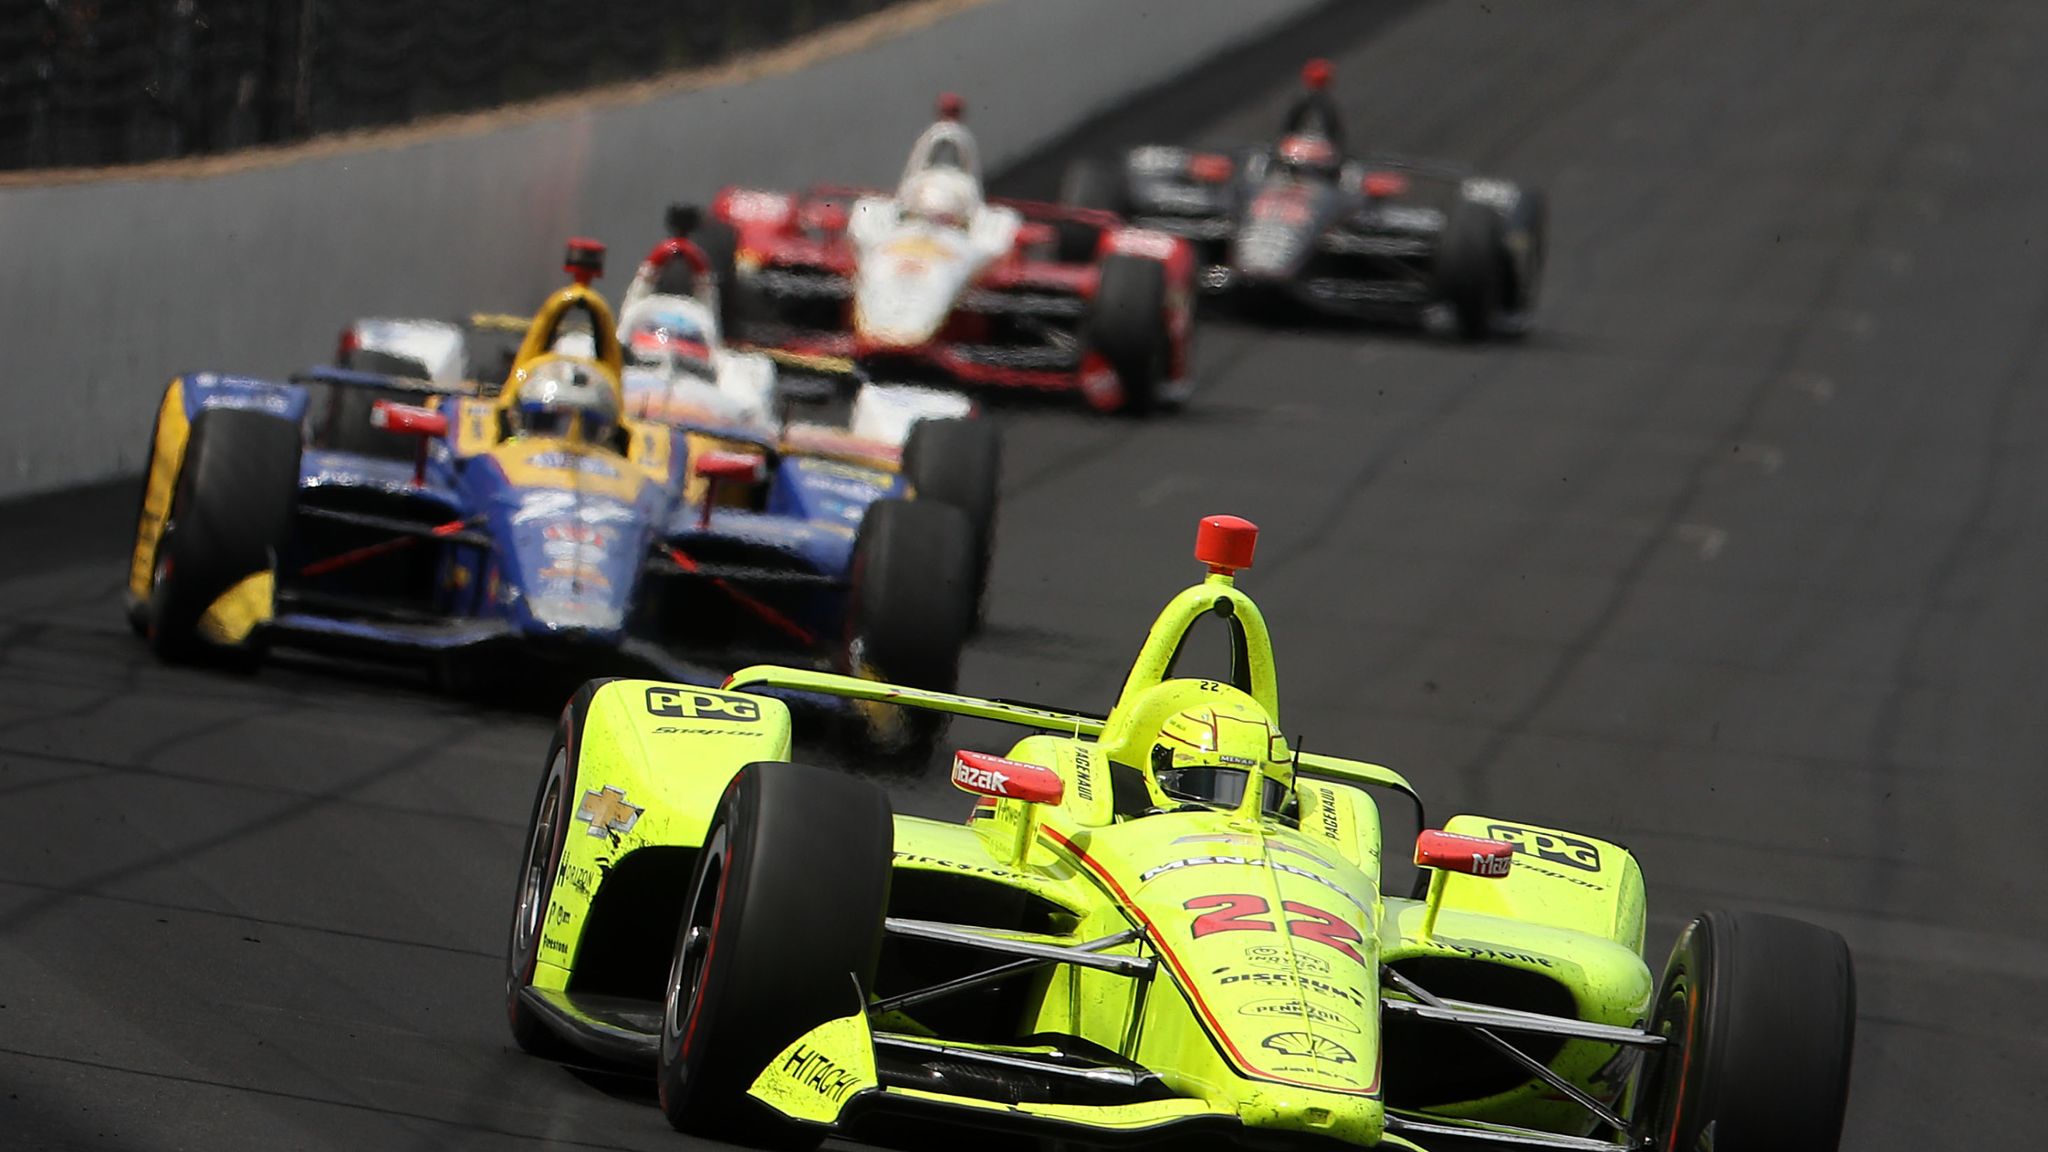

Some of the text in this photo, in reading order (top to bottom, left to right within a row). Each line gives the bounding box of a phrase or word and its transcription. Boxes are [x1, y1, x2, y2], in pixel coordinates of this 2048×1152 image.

[649, 690, 757, 718] PPG
[1200, 680, 1219, 692] 22
[652, 726, 764, 736] Snap-on
[1074, 746, 1093, 802] PAGENAUD
[1320, 787, 1341, 841] PAGENAUD
[1471, 853, 1511, 875] Maz
[1183, 893, 1367, 969] 22
[783, 1043, 862, 1103] HITACHI
